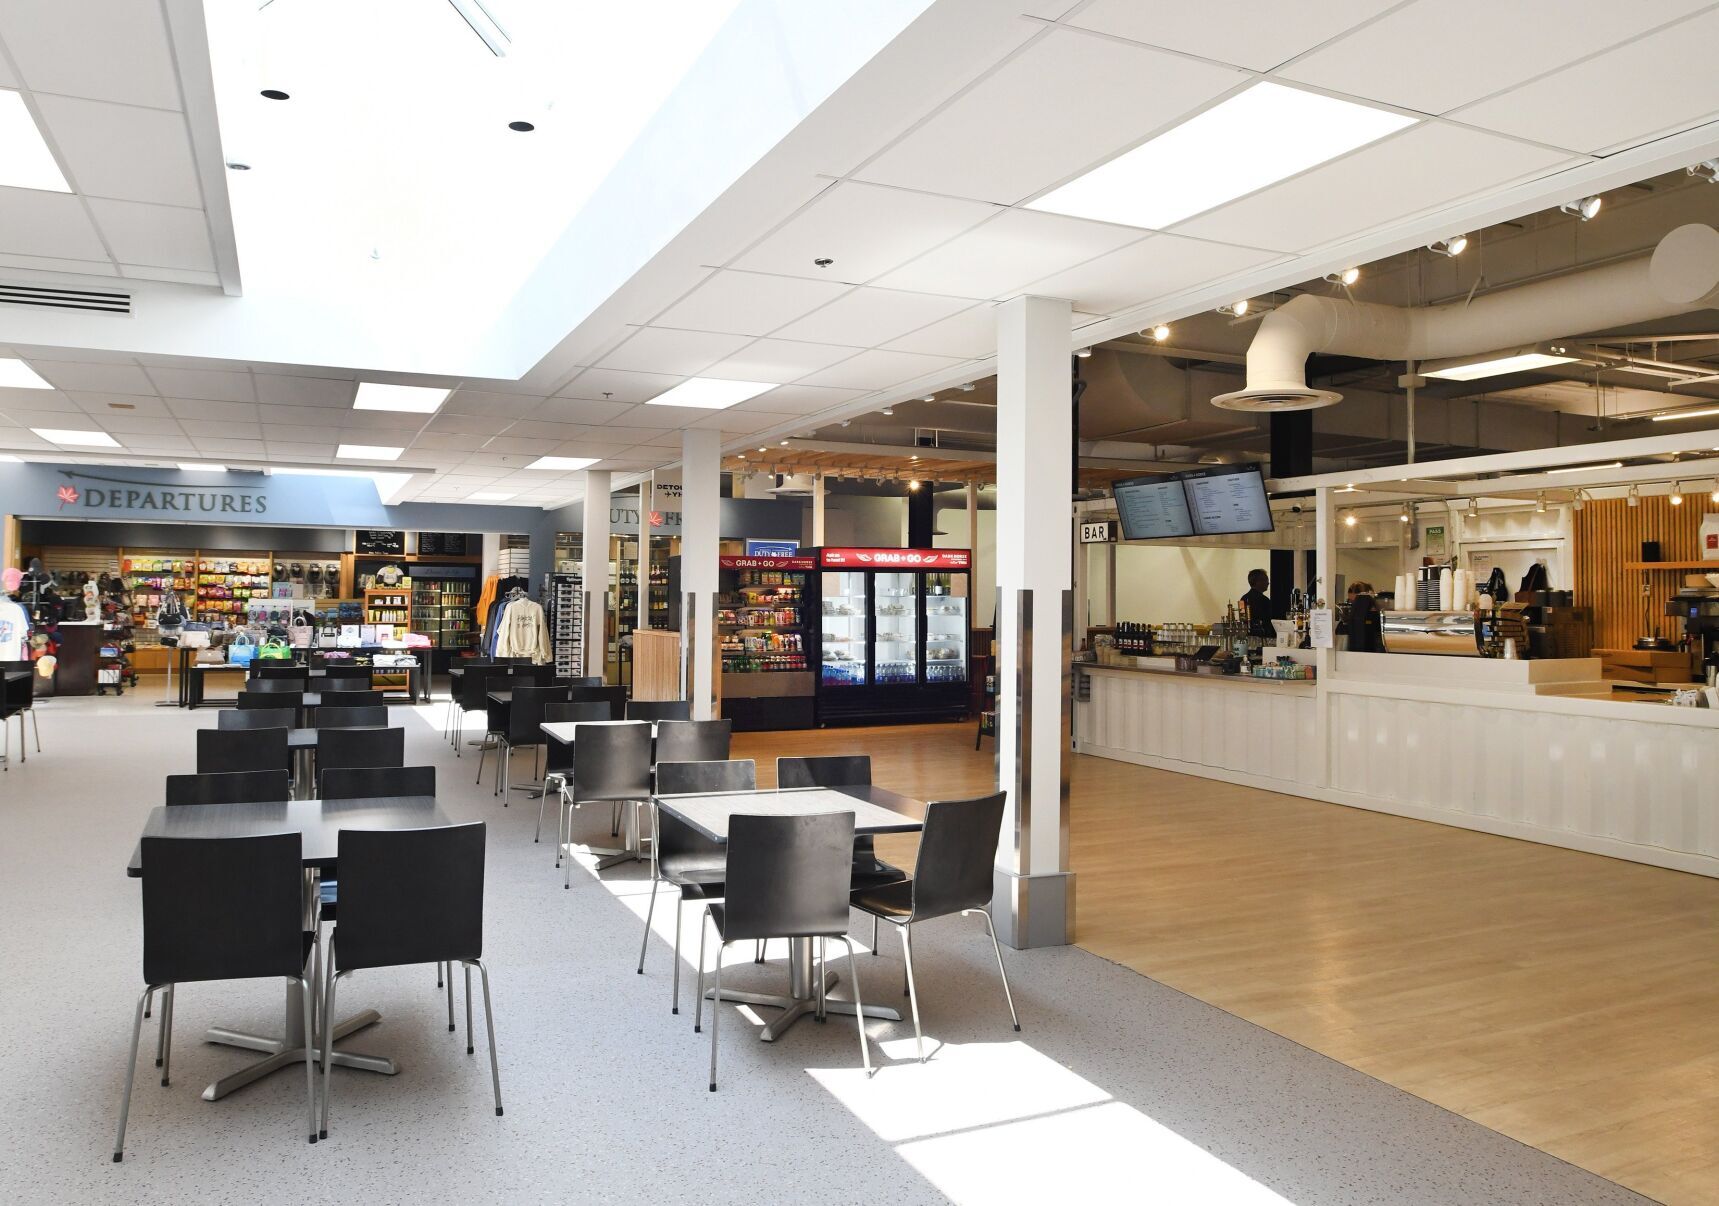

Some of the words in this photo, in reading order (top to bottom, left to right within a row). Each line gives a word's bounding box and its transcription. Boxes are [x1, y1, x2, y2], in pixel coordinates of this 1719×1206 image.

[84, 488, 267, 513] DEPARTURES
[610, 508, 639, 524] UTY
[1084, 525, 1105, 539] BAR
[735, 559, 757, 567] GRAB
[762, 559, 775, 567] GO
[873, 553, 900, 563] GRAB
[906, 553, 922, 563] GO
